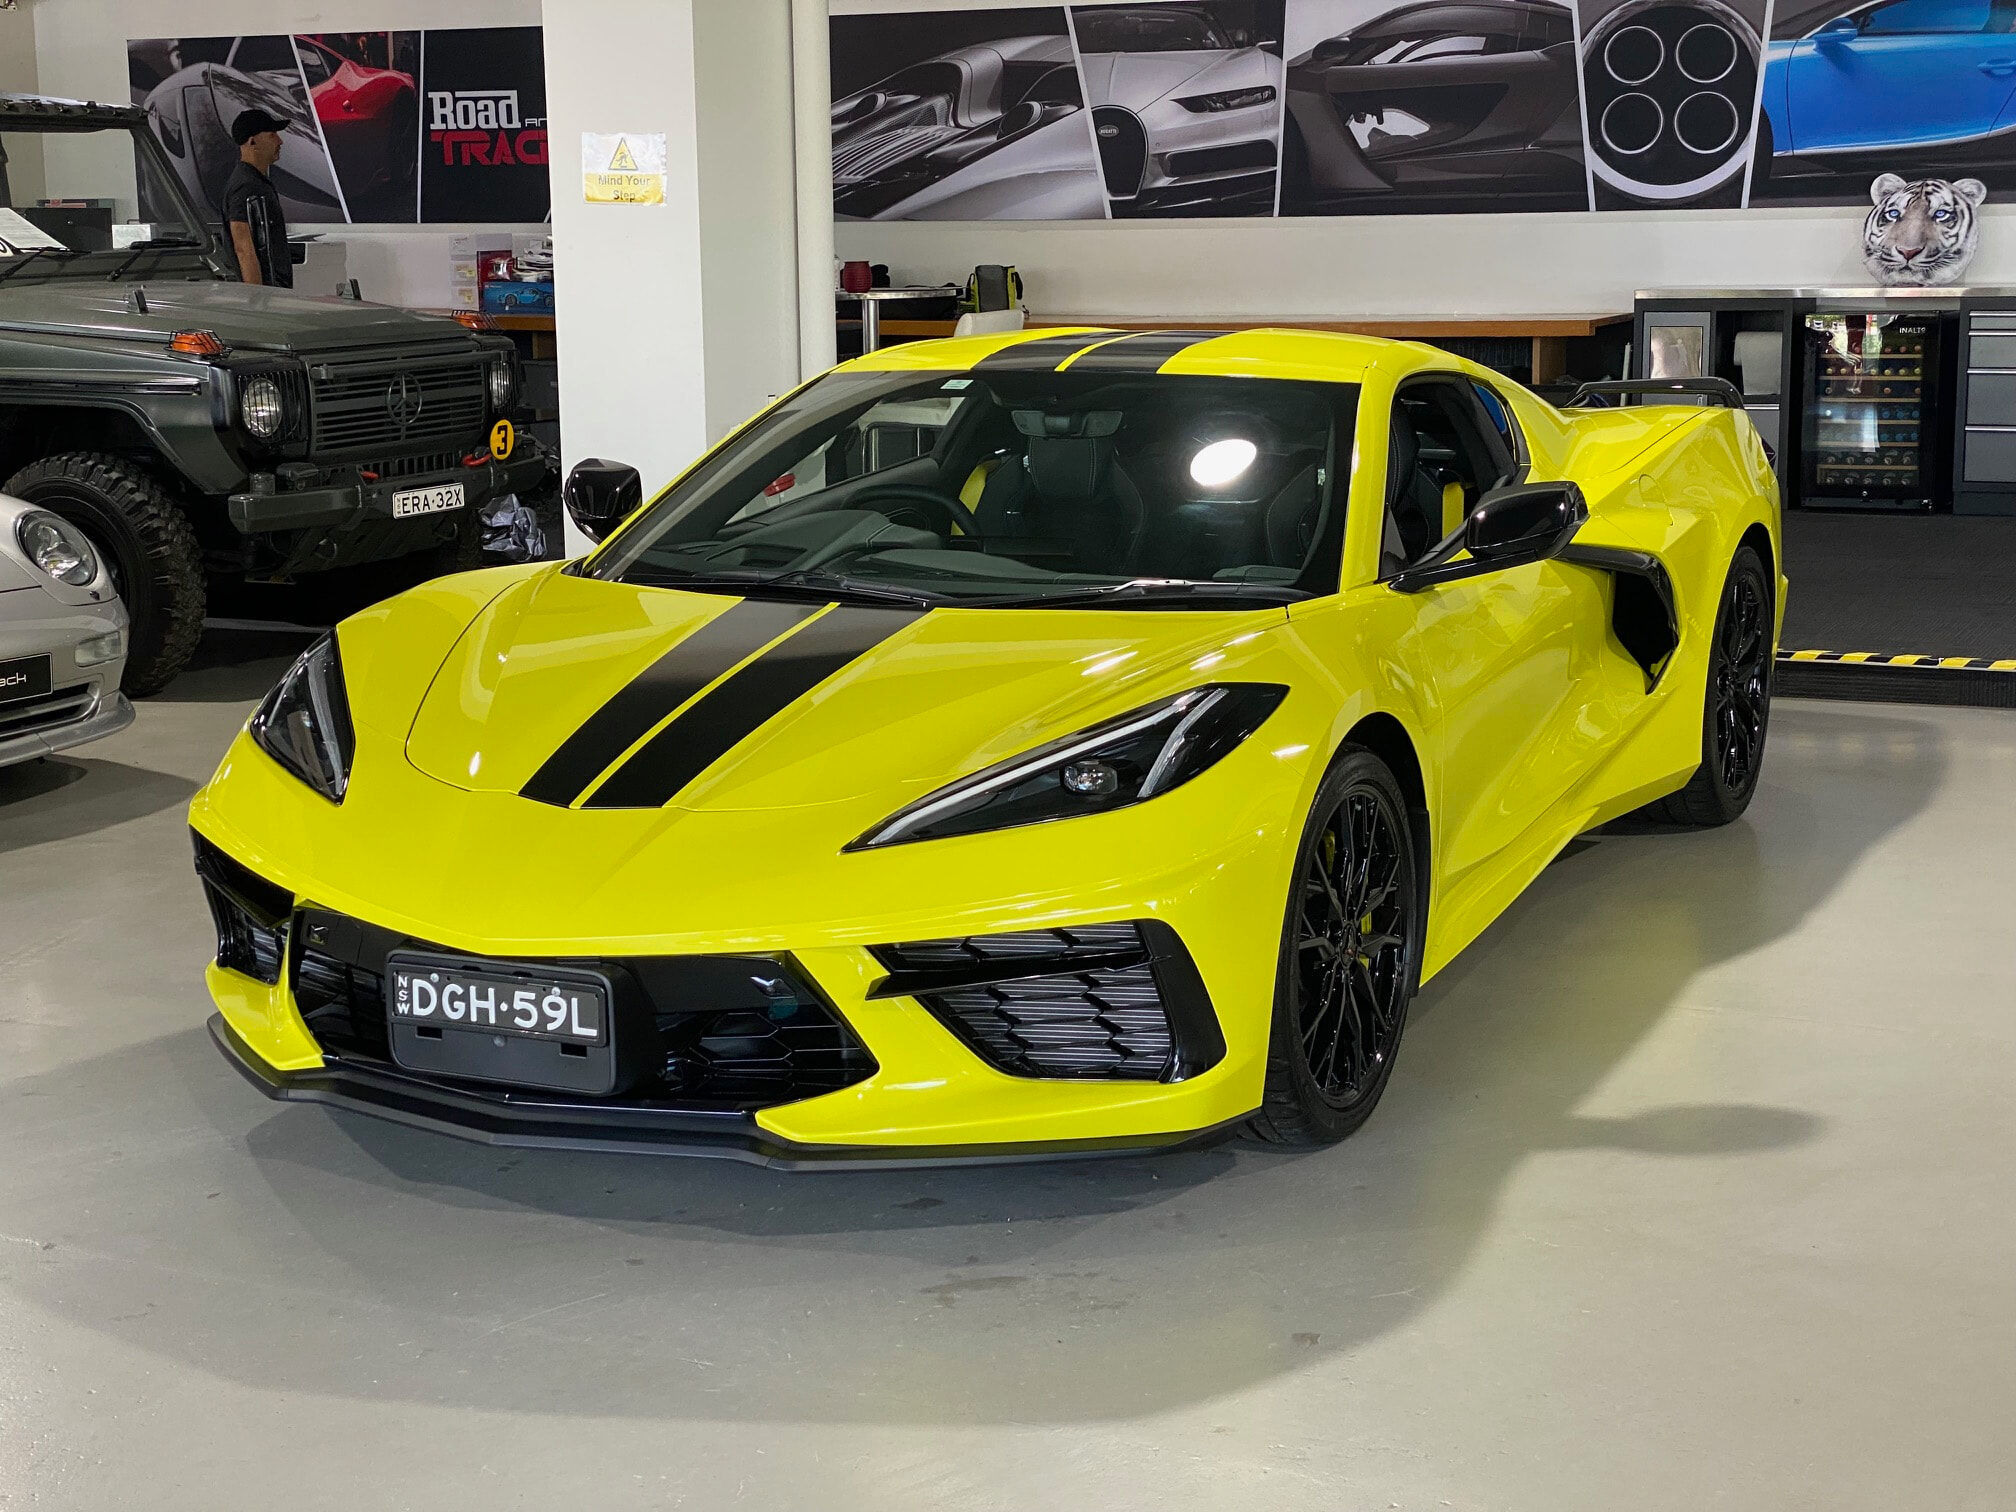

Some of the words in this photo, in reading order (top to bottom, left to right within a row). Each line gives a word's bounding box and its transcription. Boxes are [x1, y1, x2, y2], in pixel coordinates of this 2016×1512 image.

[428, 90, 521, 130] Road
[598, 174, 623, 185] Mind
[625, 175, 650, 185] Your
[613, 190, 636, 202] Step
[497, 425, 508, 455] 3
[397, 975, 410, 1015] NSW
